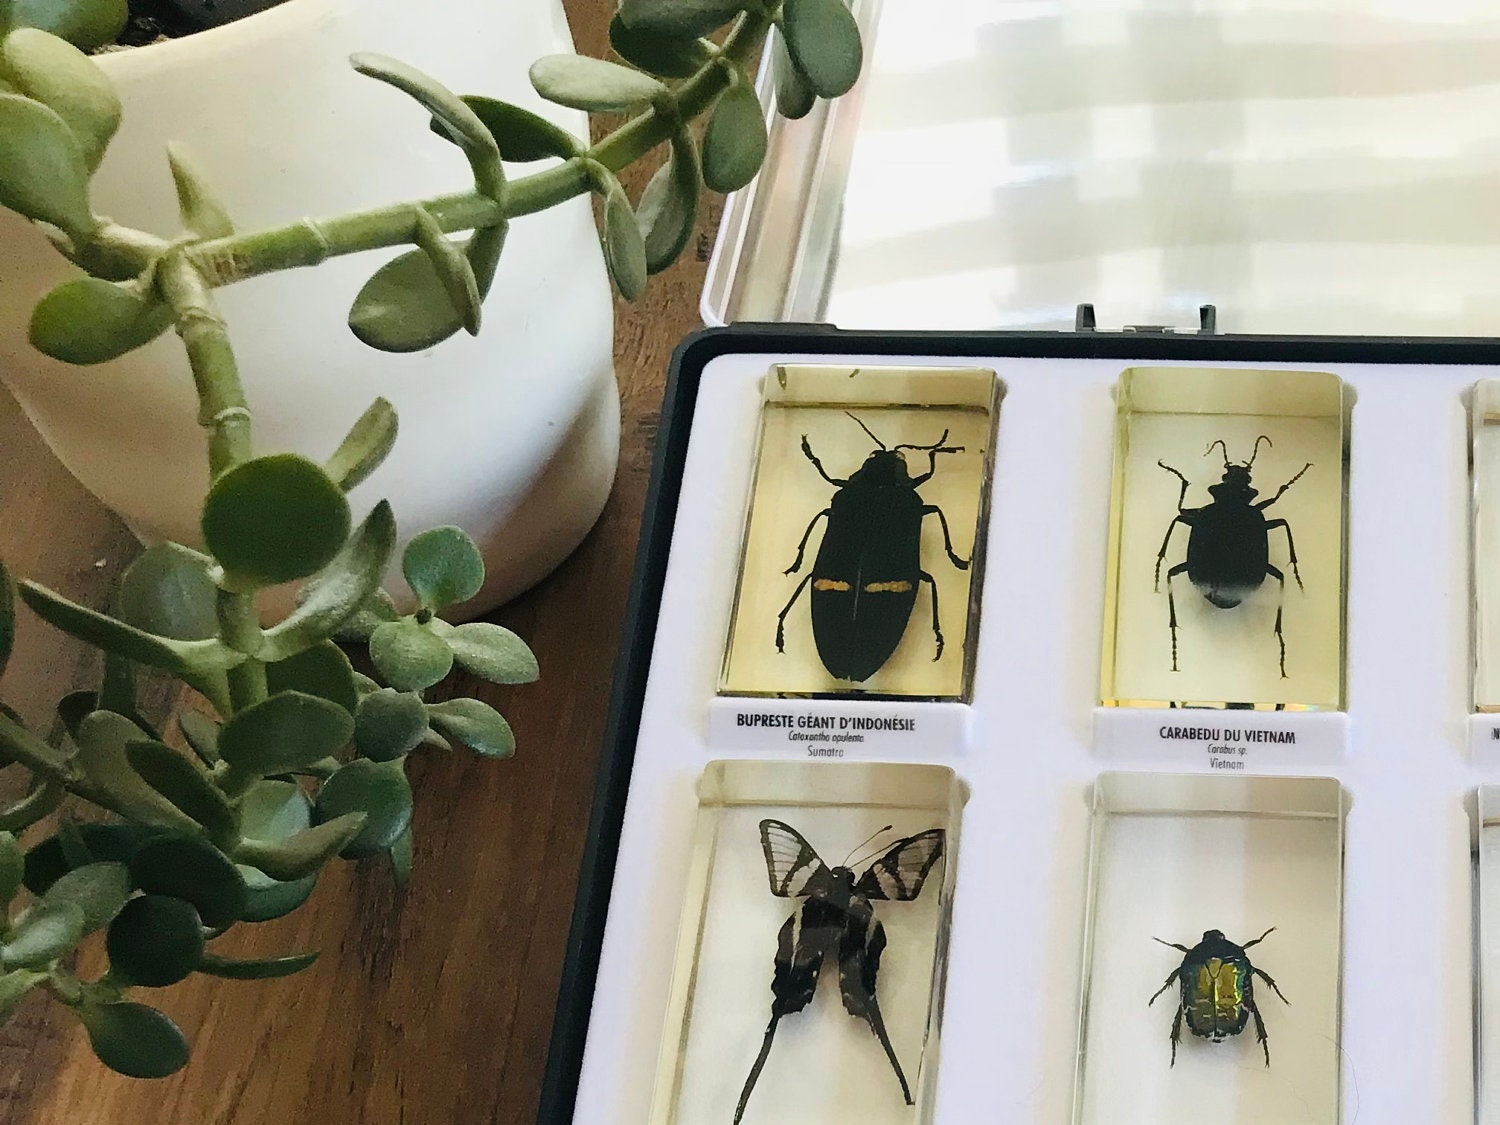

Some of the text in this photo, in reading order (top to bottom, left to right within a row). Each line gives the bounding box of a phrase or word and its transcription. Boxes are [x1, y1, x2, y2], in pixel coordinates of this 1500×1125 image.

[737, 713, 794, 728] BUPRESTE
[797, 713, 835, 729] GÉANT
[1159, 726, 1295, 744] CARABEDU DU VIETNAM
[808, 746, 844, 758] Sumatra
[1208, 744, 1236, 754] Carabus
[1210, 758, 1244, 770] Vietnam
